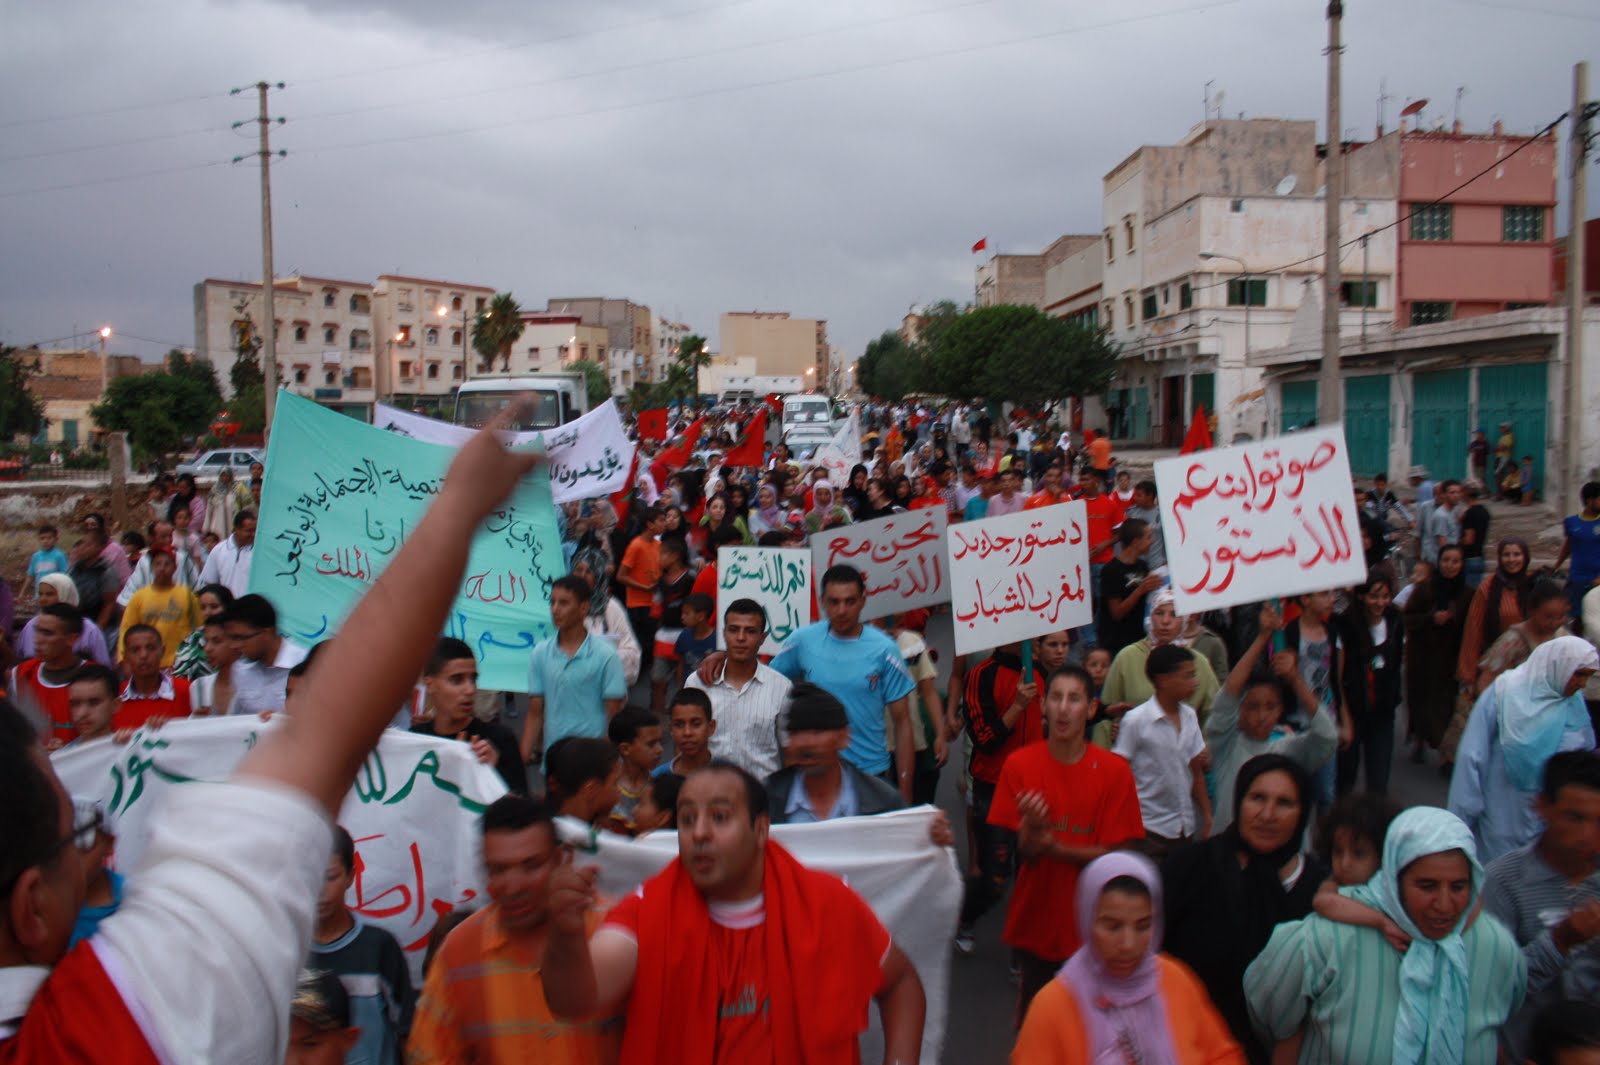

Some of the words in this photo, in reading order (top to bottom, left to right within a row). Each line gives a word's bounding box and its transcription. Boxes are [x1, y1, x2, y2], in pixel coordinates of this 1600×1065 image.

[828, 537, 872, 570] مع
[872, 511, 940, 563] نحن
[954, 528, 1016, 560] جديد
[1008, 519, 1083, 567] دستور
[316, 545, 371, 582] الملك
[780, 558, 806, 603] نعم
[956, 571, 1034, 628] الشباب
[1029, 564, 1085, 624] لمغرب
